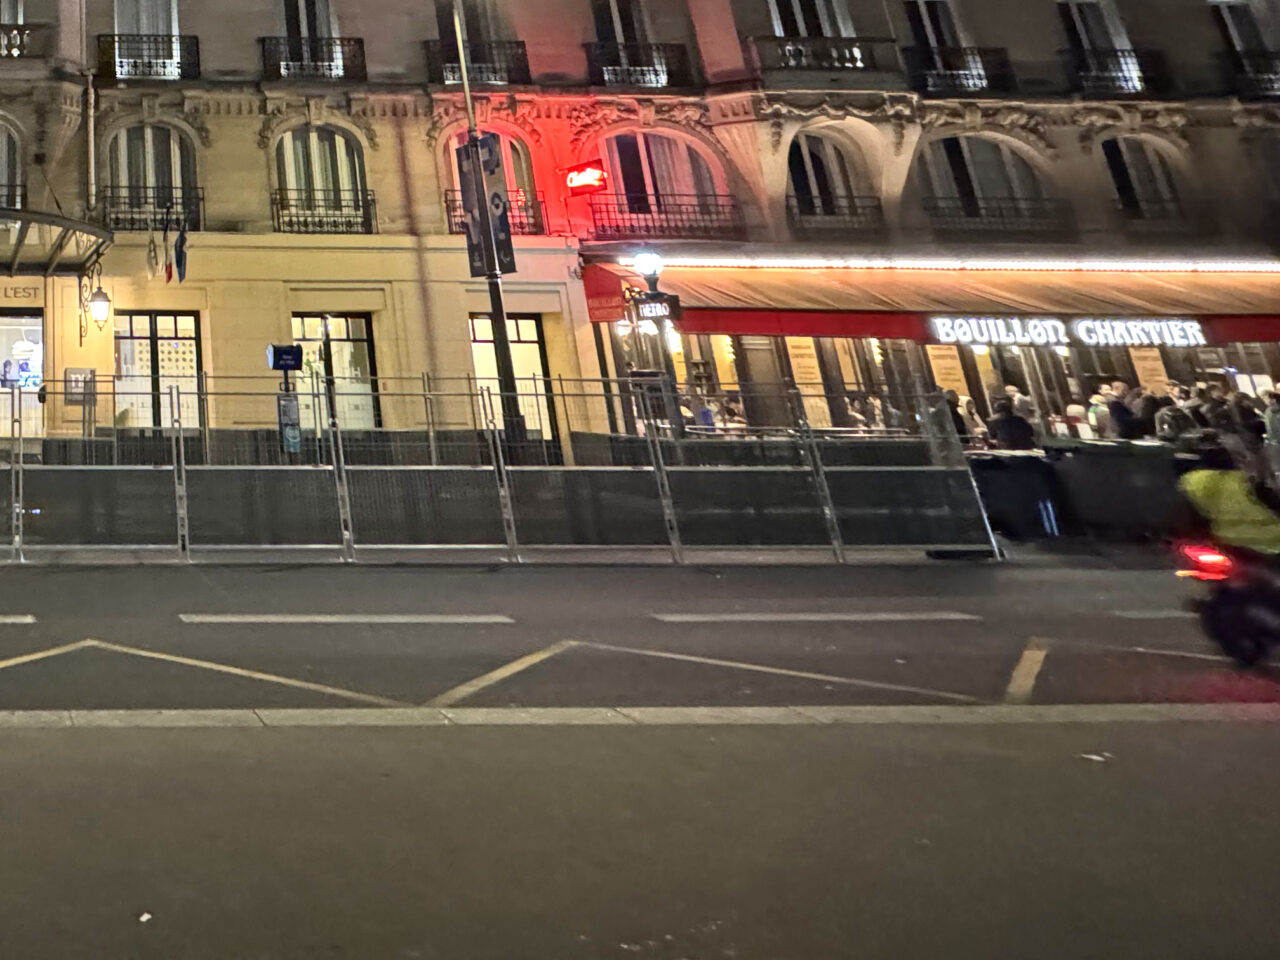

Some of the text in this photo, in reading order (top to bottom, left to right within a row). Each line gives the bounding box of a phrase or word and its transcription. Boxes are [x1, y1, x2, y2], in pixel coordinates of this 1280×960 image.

[4, 287, 40, 298] L'EST
[933, 317, 1207, 347] BOUILLON CHARTIER
